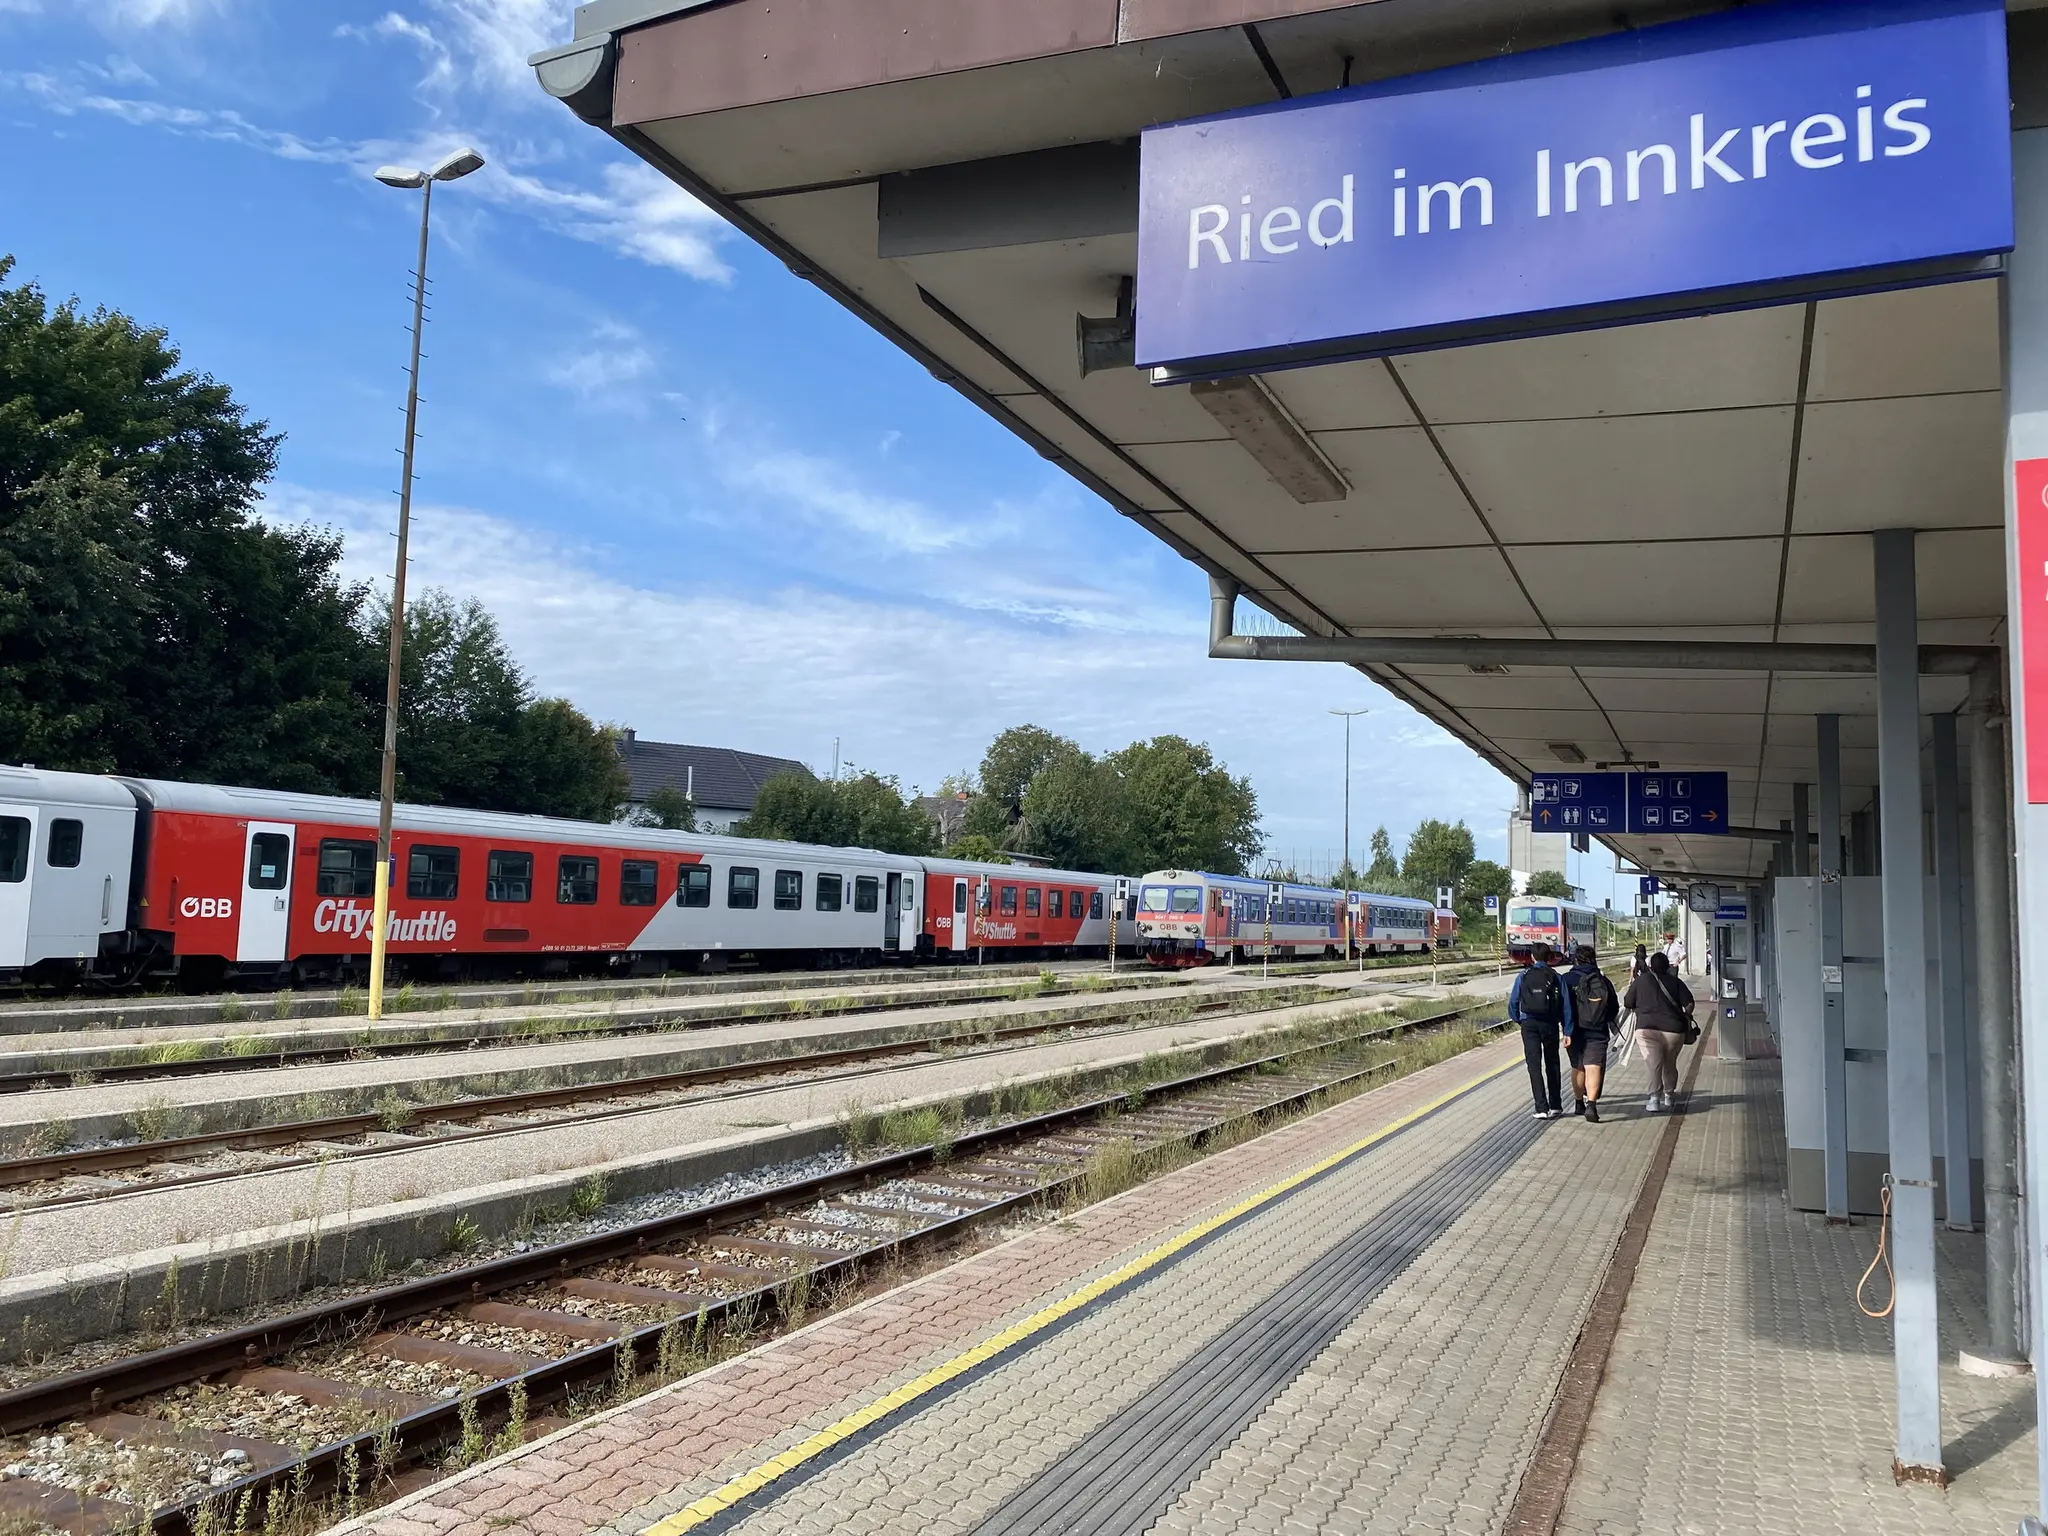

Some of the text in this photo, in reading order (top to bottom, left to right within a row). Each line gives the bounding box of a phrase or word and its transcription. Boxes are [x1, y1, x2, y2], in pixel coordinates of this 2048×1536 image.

[1188, 84, 1931, 270] Ried im Innkreis
[1117, 880, 1130, 899] H
[1269, 884, 1283, 904] H
[1646, 880, 1652, 891] 1
[180, 896, 232, 918] ÖBB
[1437, 888, 1453, 908] H
[1635, 894, 1654, 917] H
